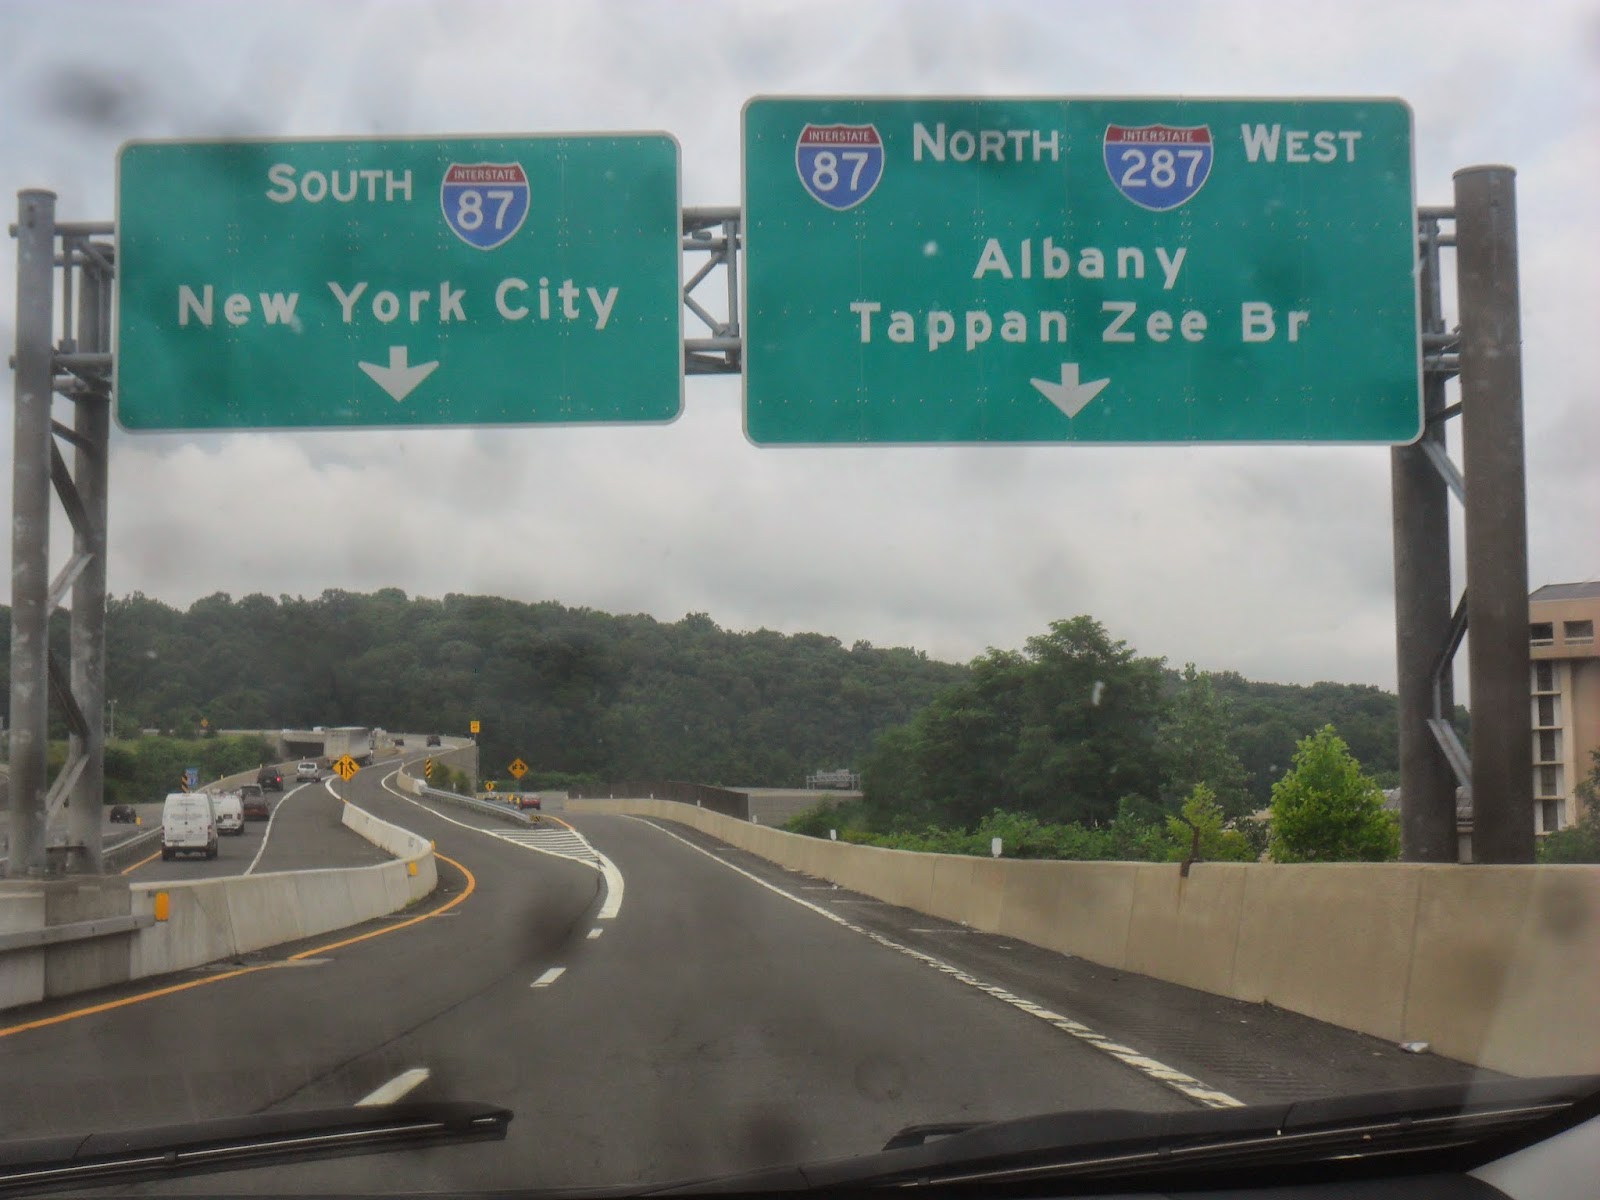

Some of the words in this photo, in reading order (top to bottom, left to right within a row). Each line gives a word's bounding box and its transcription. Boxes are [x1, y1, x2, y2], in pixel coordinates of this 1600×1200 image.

[809, 129, 871, 142] INTERSTATE
[913, 122, 1060, 162] NORTH
[1122, 129, 1195, 142] INTERSTATE
[1241, 124, 1361, 163] WEST
[266, 163, 412, 203] SOUTH
[454, 168, 517, 181] INTERSTATE
[812, 151, 868, 192] 87
[1121, 149, 1203, 187] 287
[457, 190, 514, 230] 87
[973, 238, 1188, 290] Albany
[178, 284, 299, 327] New
[328, 281, 467, 325] York
[495, 277, 619, 330] City
[850, 301, 1068, 352] Tappan
[1102, 301, 1208, 343] Zee
[1242, 301, 1310, 343] Br
